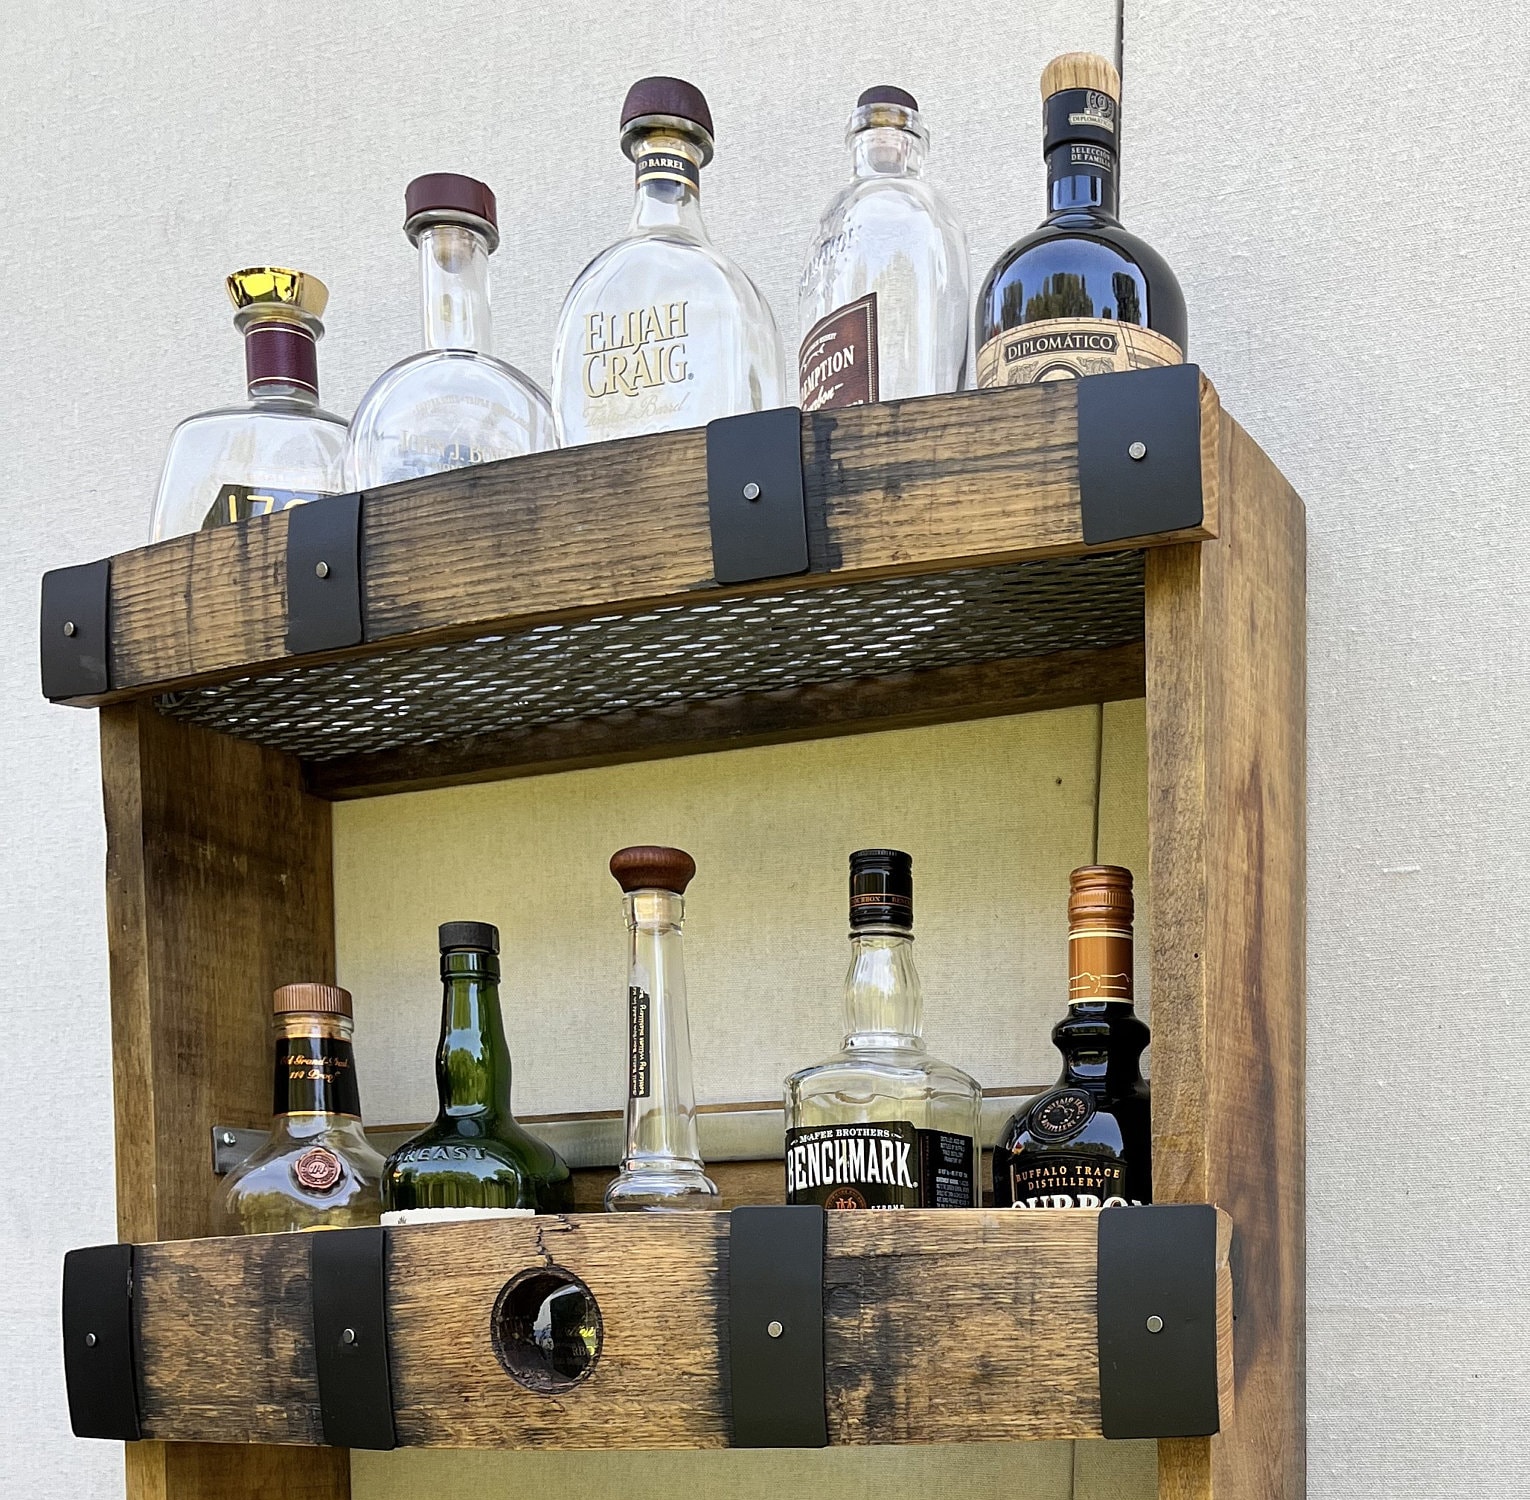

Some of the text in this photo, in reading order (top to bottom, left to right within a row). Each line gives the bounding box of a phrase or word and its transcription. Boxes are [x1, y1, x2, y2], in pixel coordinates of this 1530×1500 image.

[648, 158, 685, 171] BARREL
[583, 300, 689, 356] ELIJAH
[1008, 332, 1113, 361] DIPLOMÁTICO
[582, 343, 688, 398] CRAIG
[800, 344, 855, 404] EMPTION
[835, 1128, 890, 1138] BROTHERS
[1016, 1165, 1120, 1183] BUFFALO TRACE
[1028, 1177, 1104, 1191] DISTILLERY
